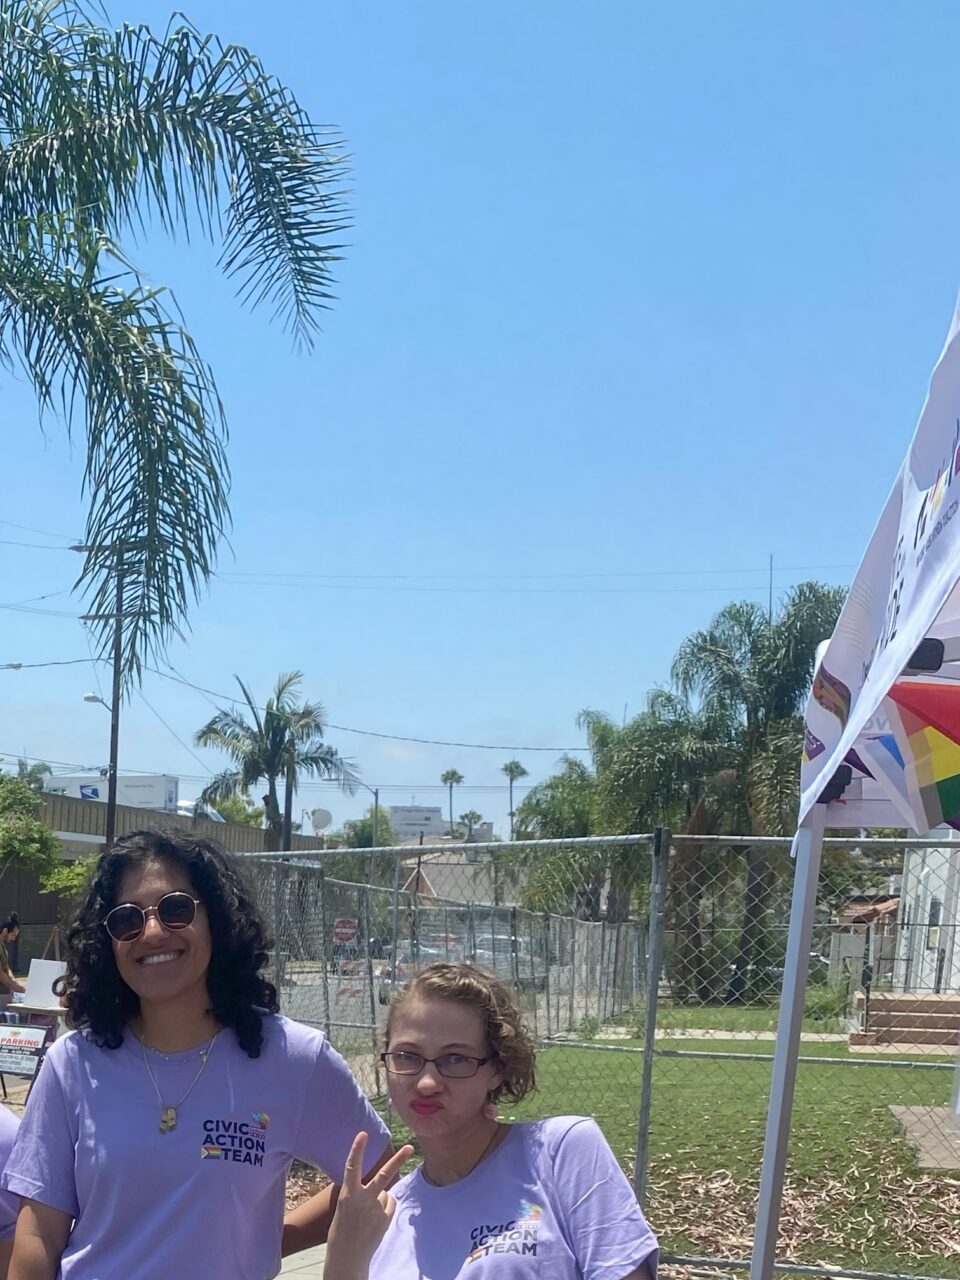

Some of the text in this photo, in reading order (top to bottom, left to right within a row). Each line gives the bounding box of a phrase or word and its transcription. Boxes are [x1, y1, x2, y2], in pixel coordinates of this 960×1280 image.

[0, 1037, 40, 1047] PARKING
[203, 1119, 250, 1135] CIVIC
[202, 1134, 266, 1153] ACTION
[221, 1148, 264, 1167] TEAM
[470, 1220, 516, 1240] CIVIC
[470, 1230, 538, 1254] ACTION
[483, 1242, 537, 1257] TEAM
